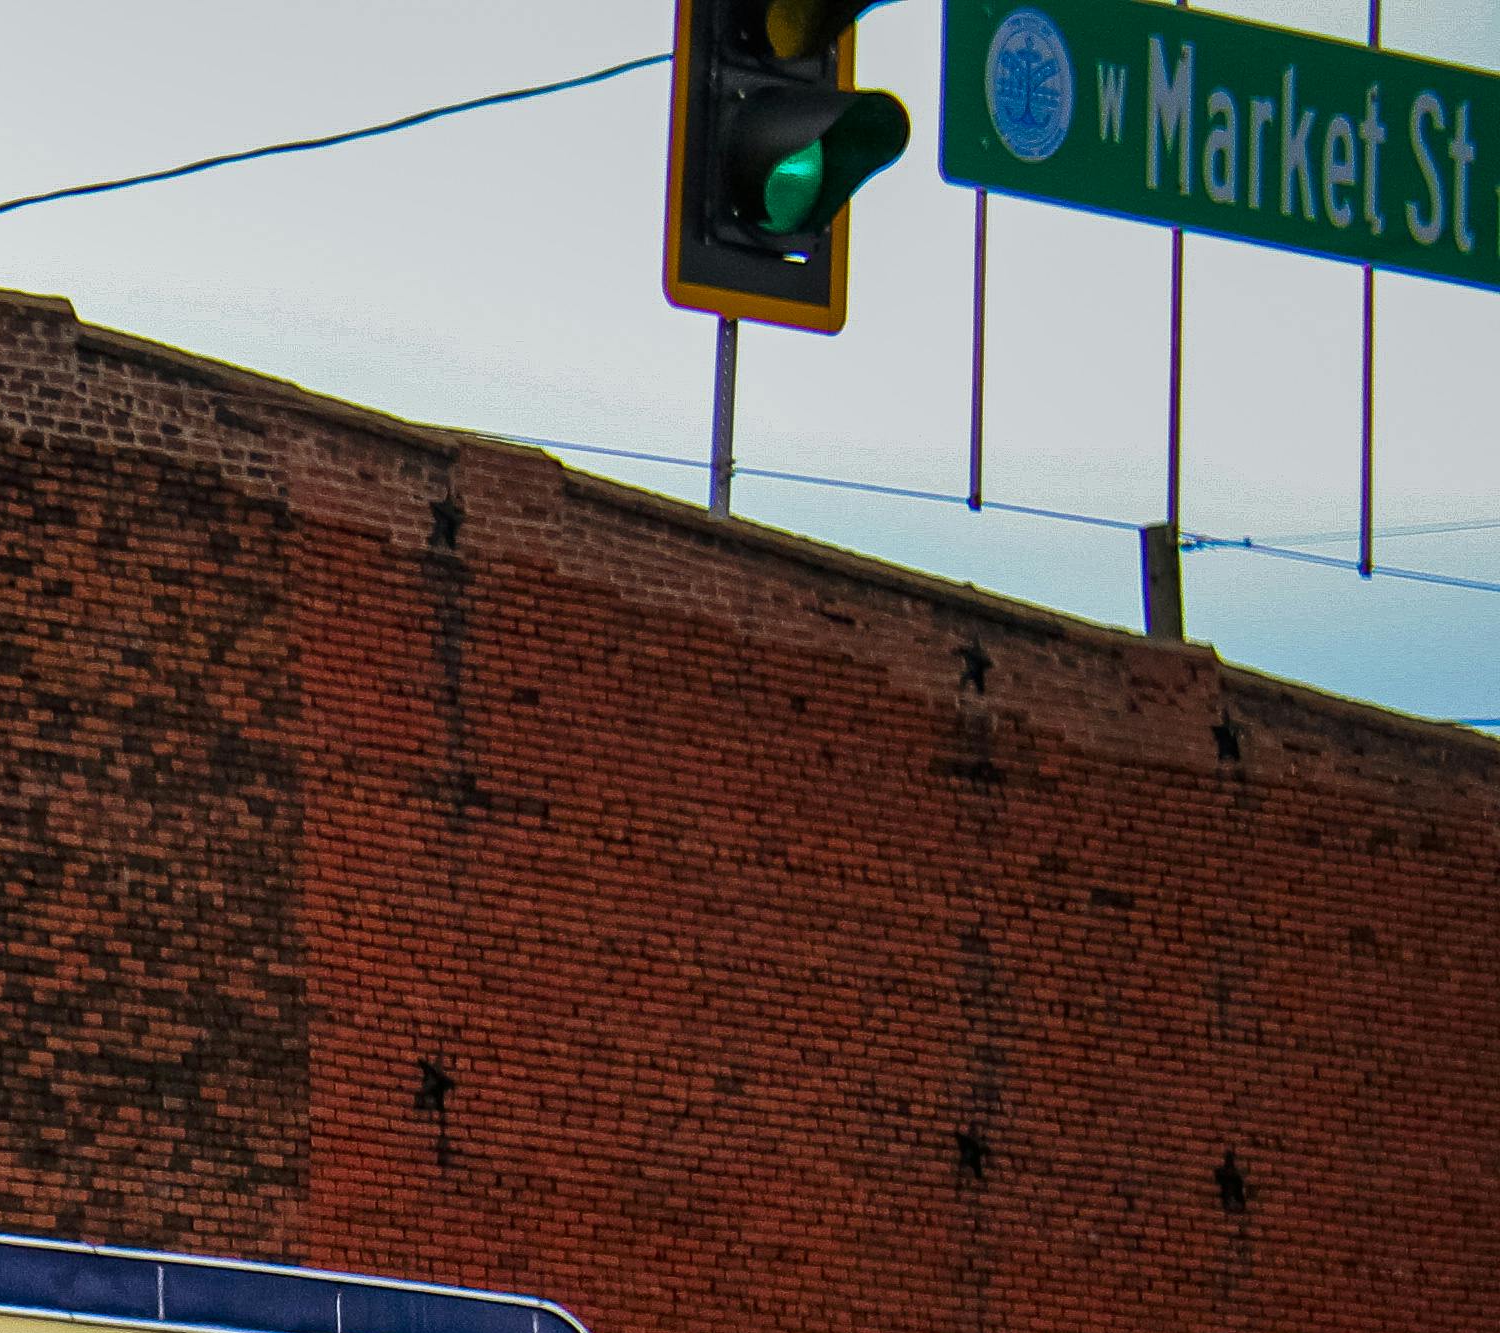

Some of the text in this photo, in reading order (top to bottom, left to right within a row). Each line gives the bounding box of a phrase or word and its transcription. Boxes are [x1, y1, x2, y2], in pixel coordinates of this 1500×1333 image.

[1097, 60, 1128, 144] W
[1147, 33, 1387, 237] Market
[1405, 89, 1476, 254] St
